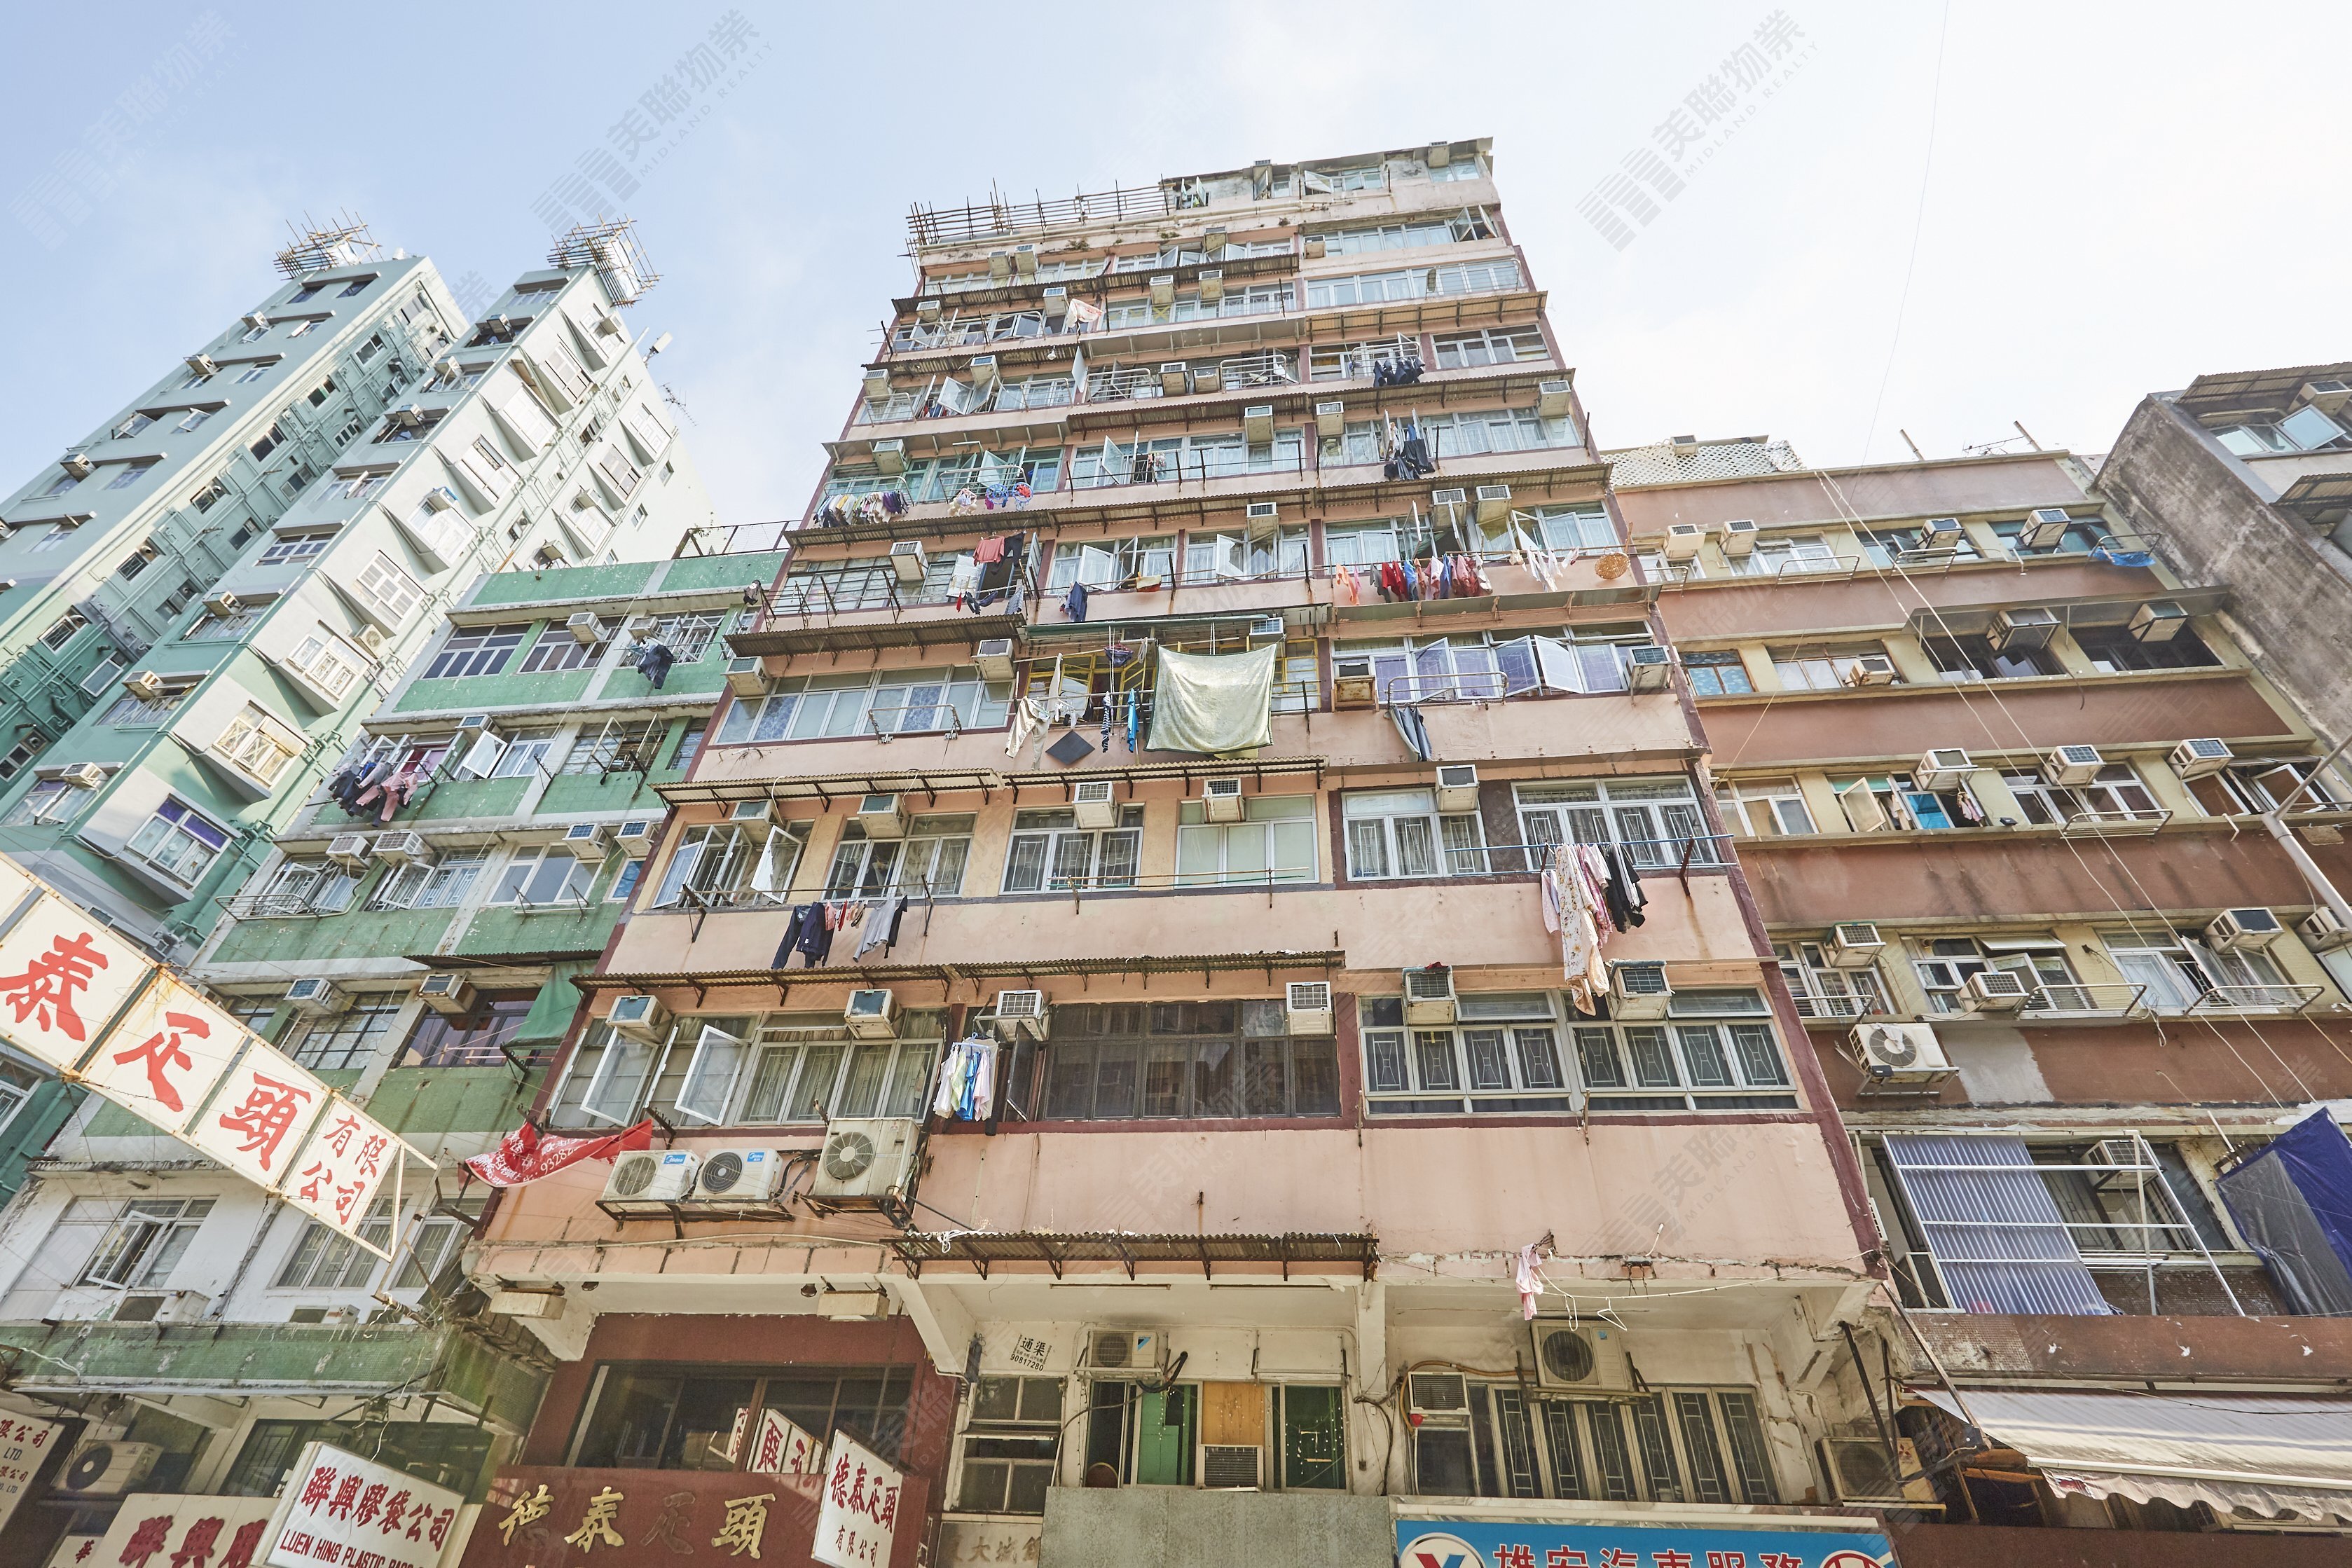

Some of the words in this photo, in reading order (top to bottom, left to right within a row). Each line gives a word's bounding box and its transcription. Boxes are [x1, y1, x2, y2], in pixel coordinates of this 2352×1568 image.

[1010, 1354, 1044, 1371] 90817280
[1019, 1337, 1046, 1357] 通渠
[301, 1466, 455, 1552] 聯興膠袋公司
[280, 1529, 313, 1556] LUEN
[312, 1538, 342, 1564] HING
[341, 1546, 386, 1568] PLASTIC
[835, 1525, 879, 1567] 有限公司
